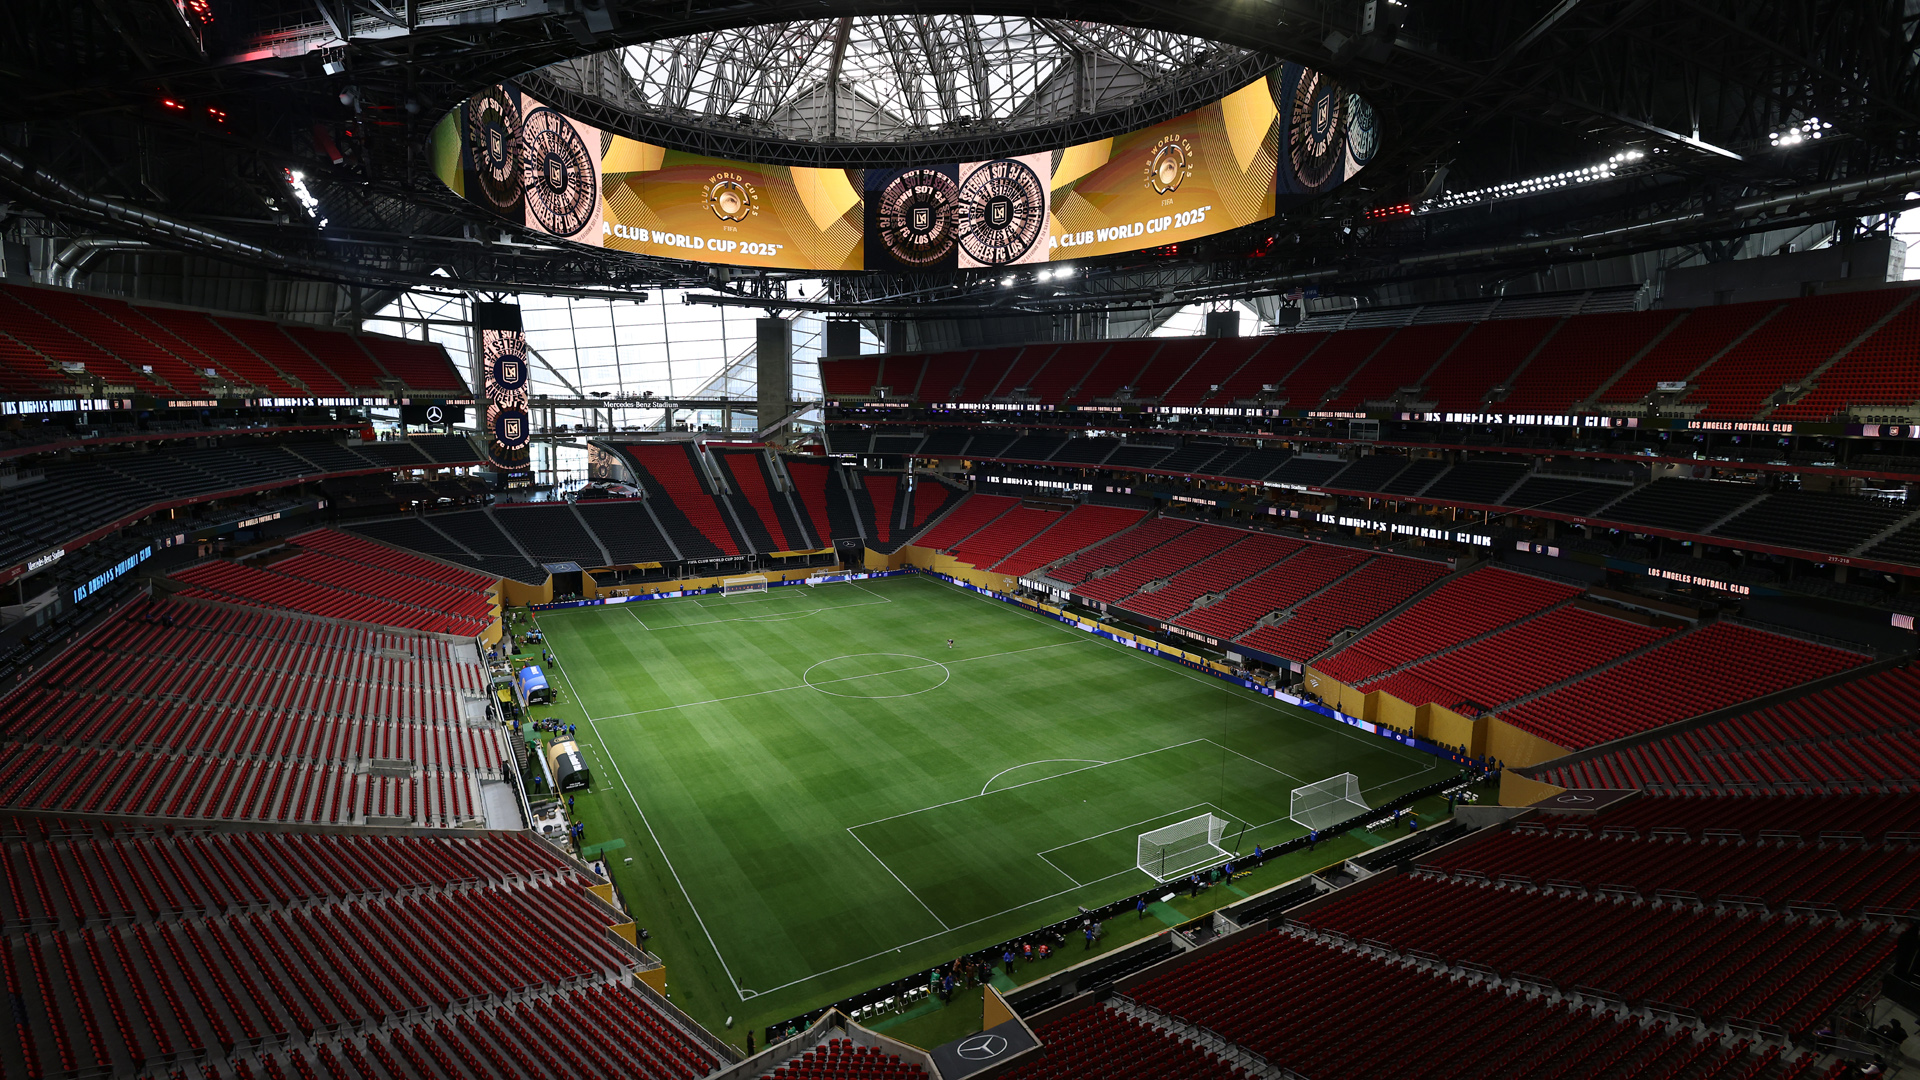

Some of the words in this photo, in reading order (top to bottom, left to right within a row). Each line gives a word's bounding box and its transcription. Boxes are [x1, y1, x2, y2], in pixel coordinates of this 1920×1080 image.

[548, 115, 560, 134] LOS
[562, 126, 572, 142] FC
[524, 143, 532, 160] FC
[1151, 134, 1180, 155] WORLD
[1182, 139, 1192, 157] CUP
[1316, 138, 1326, 158] LOS
[524, 164, 534, 186] LOS
[992, 166, 1008, 178] LOS
[1008, 166, 1020, 179] FC
[1186, 164, 1193, 177] 25
[702, 185, 710, 210] CLUB
[709, 172, 742, 184] WORLD
[744, 182, 758, 200] CUP
[752, 205, 760, 216] 25
[914, 186, 934, 194] LOS
[934, 190, 946, 204] FC
[1162, 198, 1174, 206] FIFA
[959, 206, 969, 214] FC
[554, 215, 564, 230] FC
[564, 215, 578, 231] LOS
[880, 217, 890, 228] FC
[959, 219, 971, 234] LOS
[614, 224, 650, 242] CLUB
[652, 230, 704, 250] WORLD
[707, 238, 736, 252] CUP
[882, 230, 894, 246] LOS
[900, 226, 910, 238] FC
[914, 234, 928, 244] LOS
[1060, 230, 1094, 247] CLUB
[1096, 222, 1144, 242] WORLD
[1146, 216, 1172, 234] CUP
[964, 233, 994, 260] ANGELES
[996, 248, 1006, 260] FC
[1007, 242, 1022, 256] LOS
[1688, 421, 1700, 430] LOS
[1702, 422, 1732, 430] ANGELES
[1734, 422, 1770, 432] FOOTBALL
[1772, 424, 1792, 432] CLUB
[52, 550, 65, 560] Stadium
[1648, 567, 1660, 578] LOS
[1662, 570, 1691, 584] ANGELES
[1692, 575, 1728, 592] FOOTBALL
[1730, 582, 1750, 596] CLUB
[1160, 622, 1168, 631] LOS
[1168, 624, 1186, 636] ANGELES
[1186, 629, 1206, 642] FOOTBALL
[1206, 636, 1218, 646] CLUB
